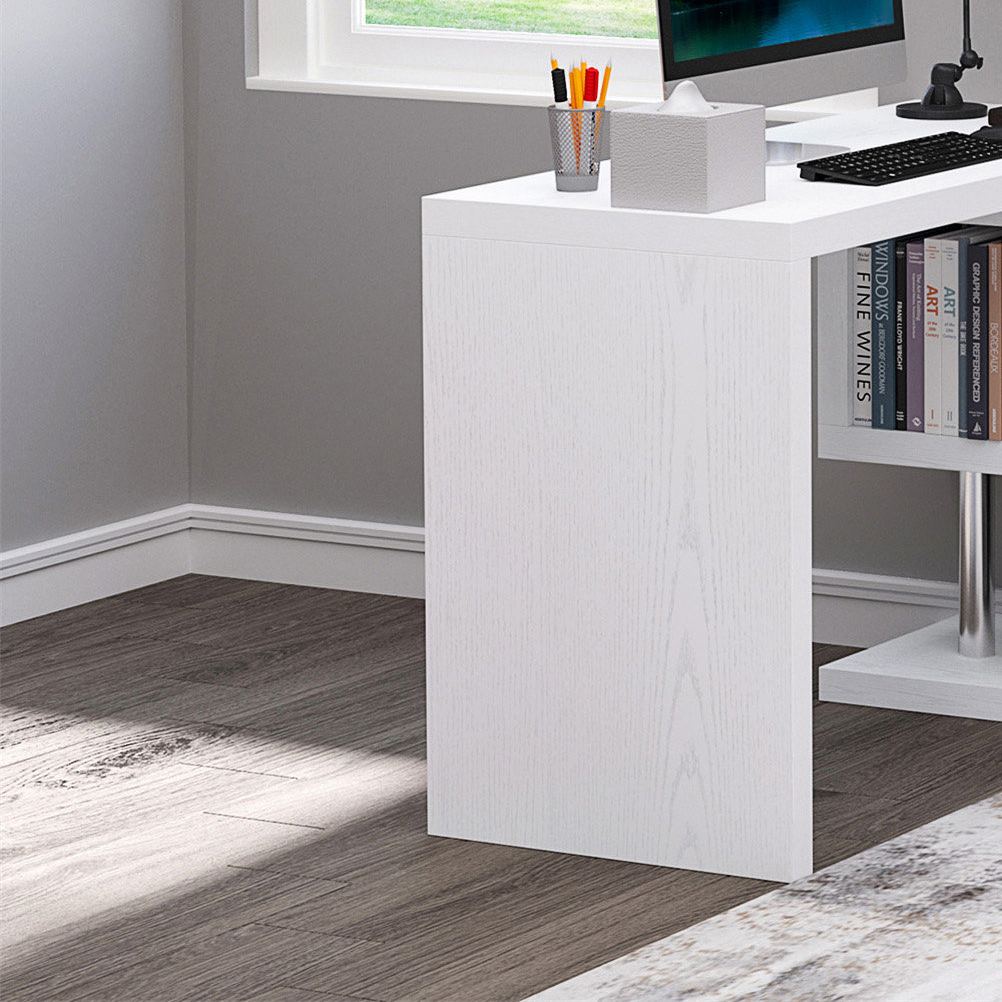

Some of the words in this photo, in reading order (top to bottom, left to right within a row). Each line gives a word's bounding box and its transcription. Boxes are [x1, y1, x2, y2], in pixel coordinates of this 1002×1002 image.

[857, 272, 871, 320] FINE
[875, 242, 889, 321] WINDOWS
[927, 285, 939, 316] ART
[944, 286, 956, 317] ART
[972, 262, 980, 303] GRAPHIC
[972, 306, 980, 340] DESIGN
[857, 331, 871, 402] WINES
[990, 322, 999, 373] BORDEAUX
[972, 342, 980, 402] REFERENCED
